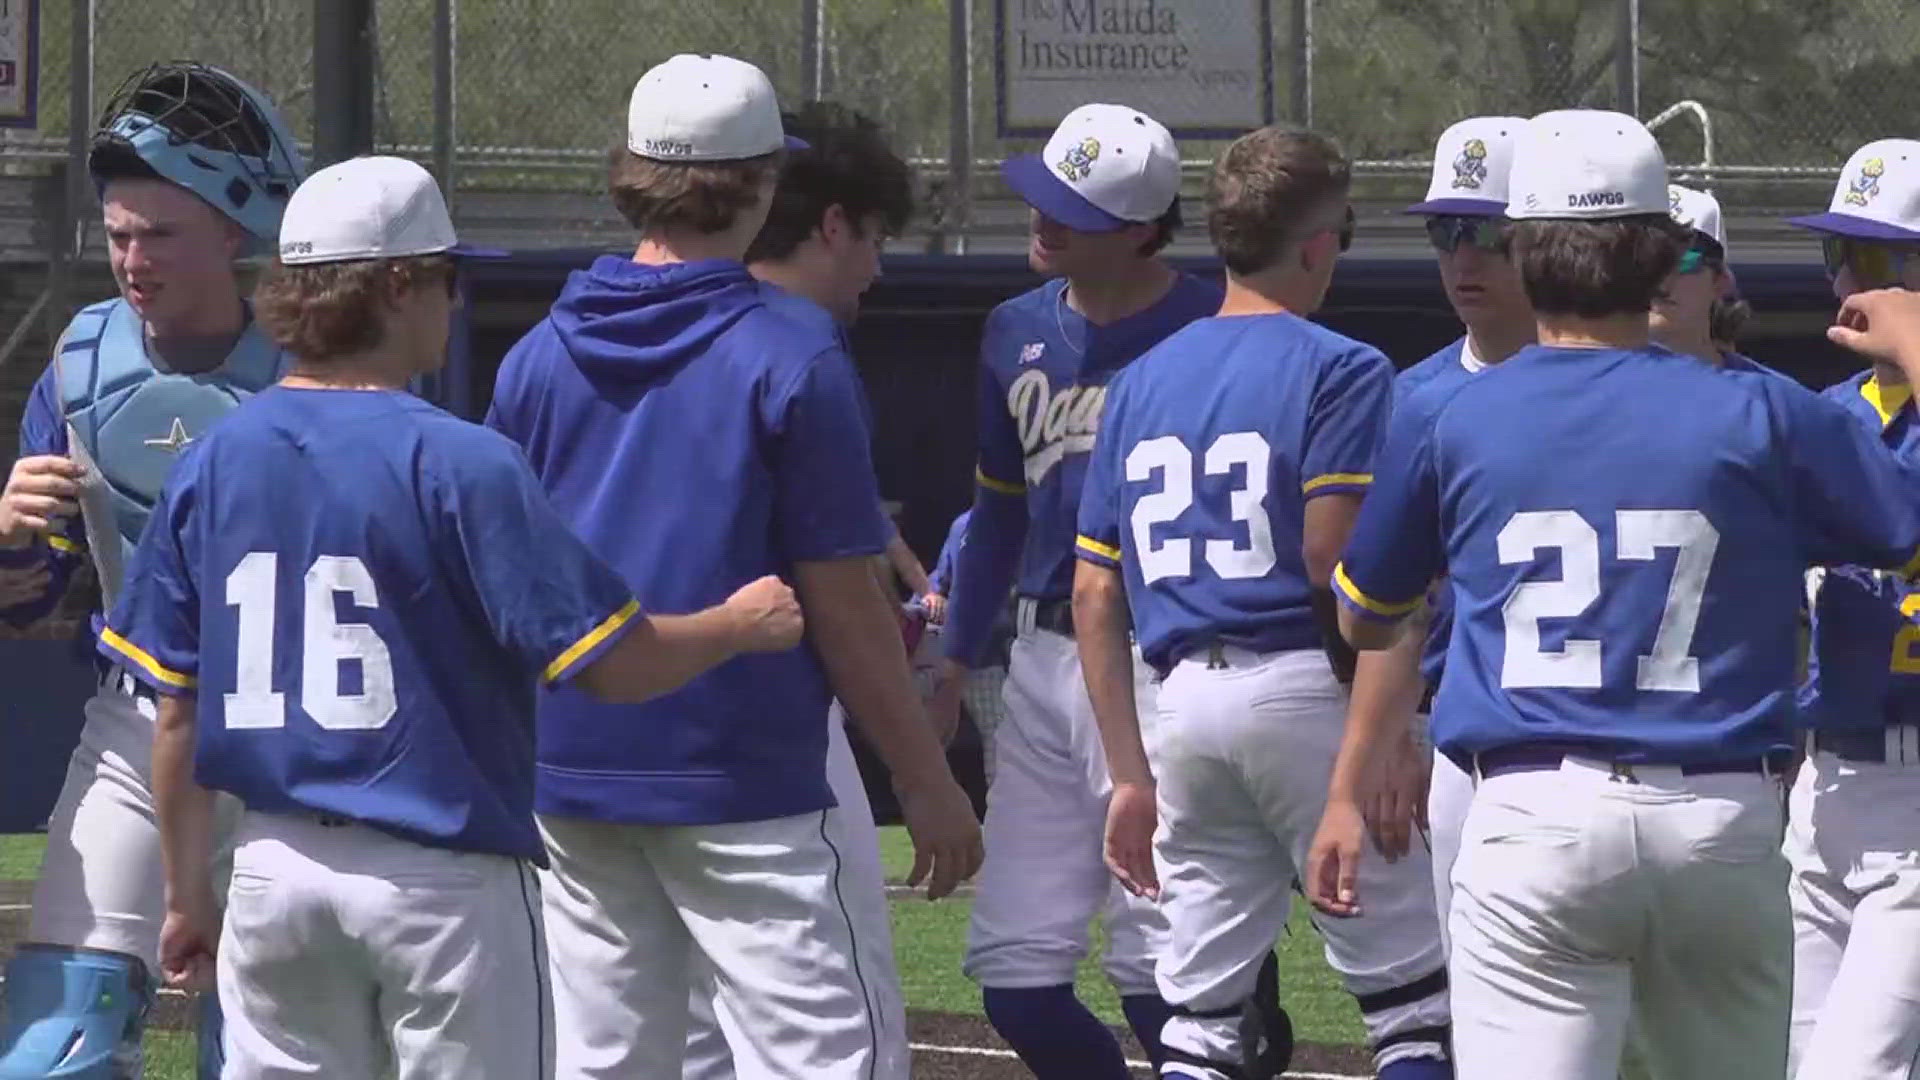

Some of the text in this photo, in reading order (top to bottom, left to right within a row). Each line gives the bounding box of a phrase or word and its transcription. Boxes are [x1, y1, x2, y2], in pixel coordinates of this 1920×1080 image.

[1020, 31, 1188, 70] Insurance
[1062, 0, 1177, 35] Maida
[1567, 191, 1625, 208] DAWGS
[1125, 431, 1276, 580] 23
[222, 550, 399, 731] 16
[1496, 509, 1721, 693] 27
